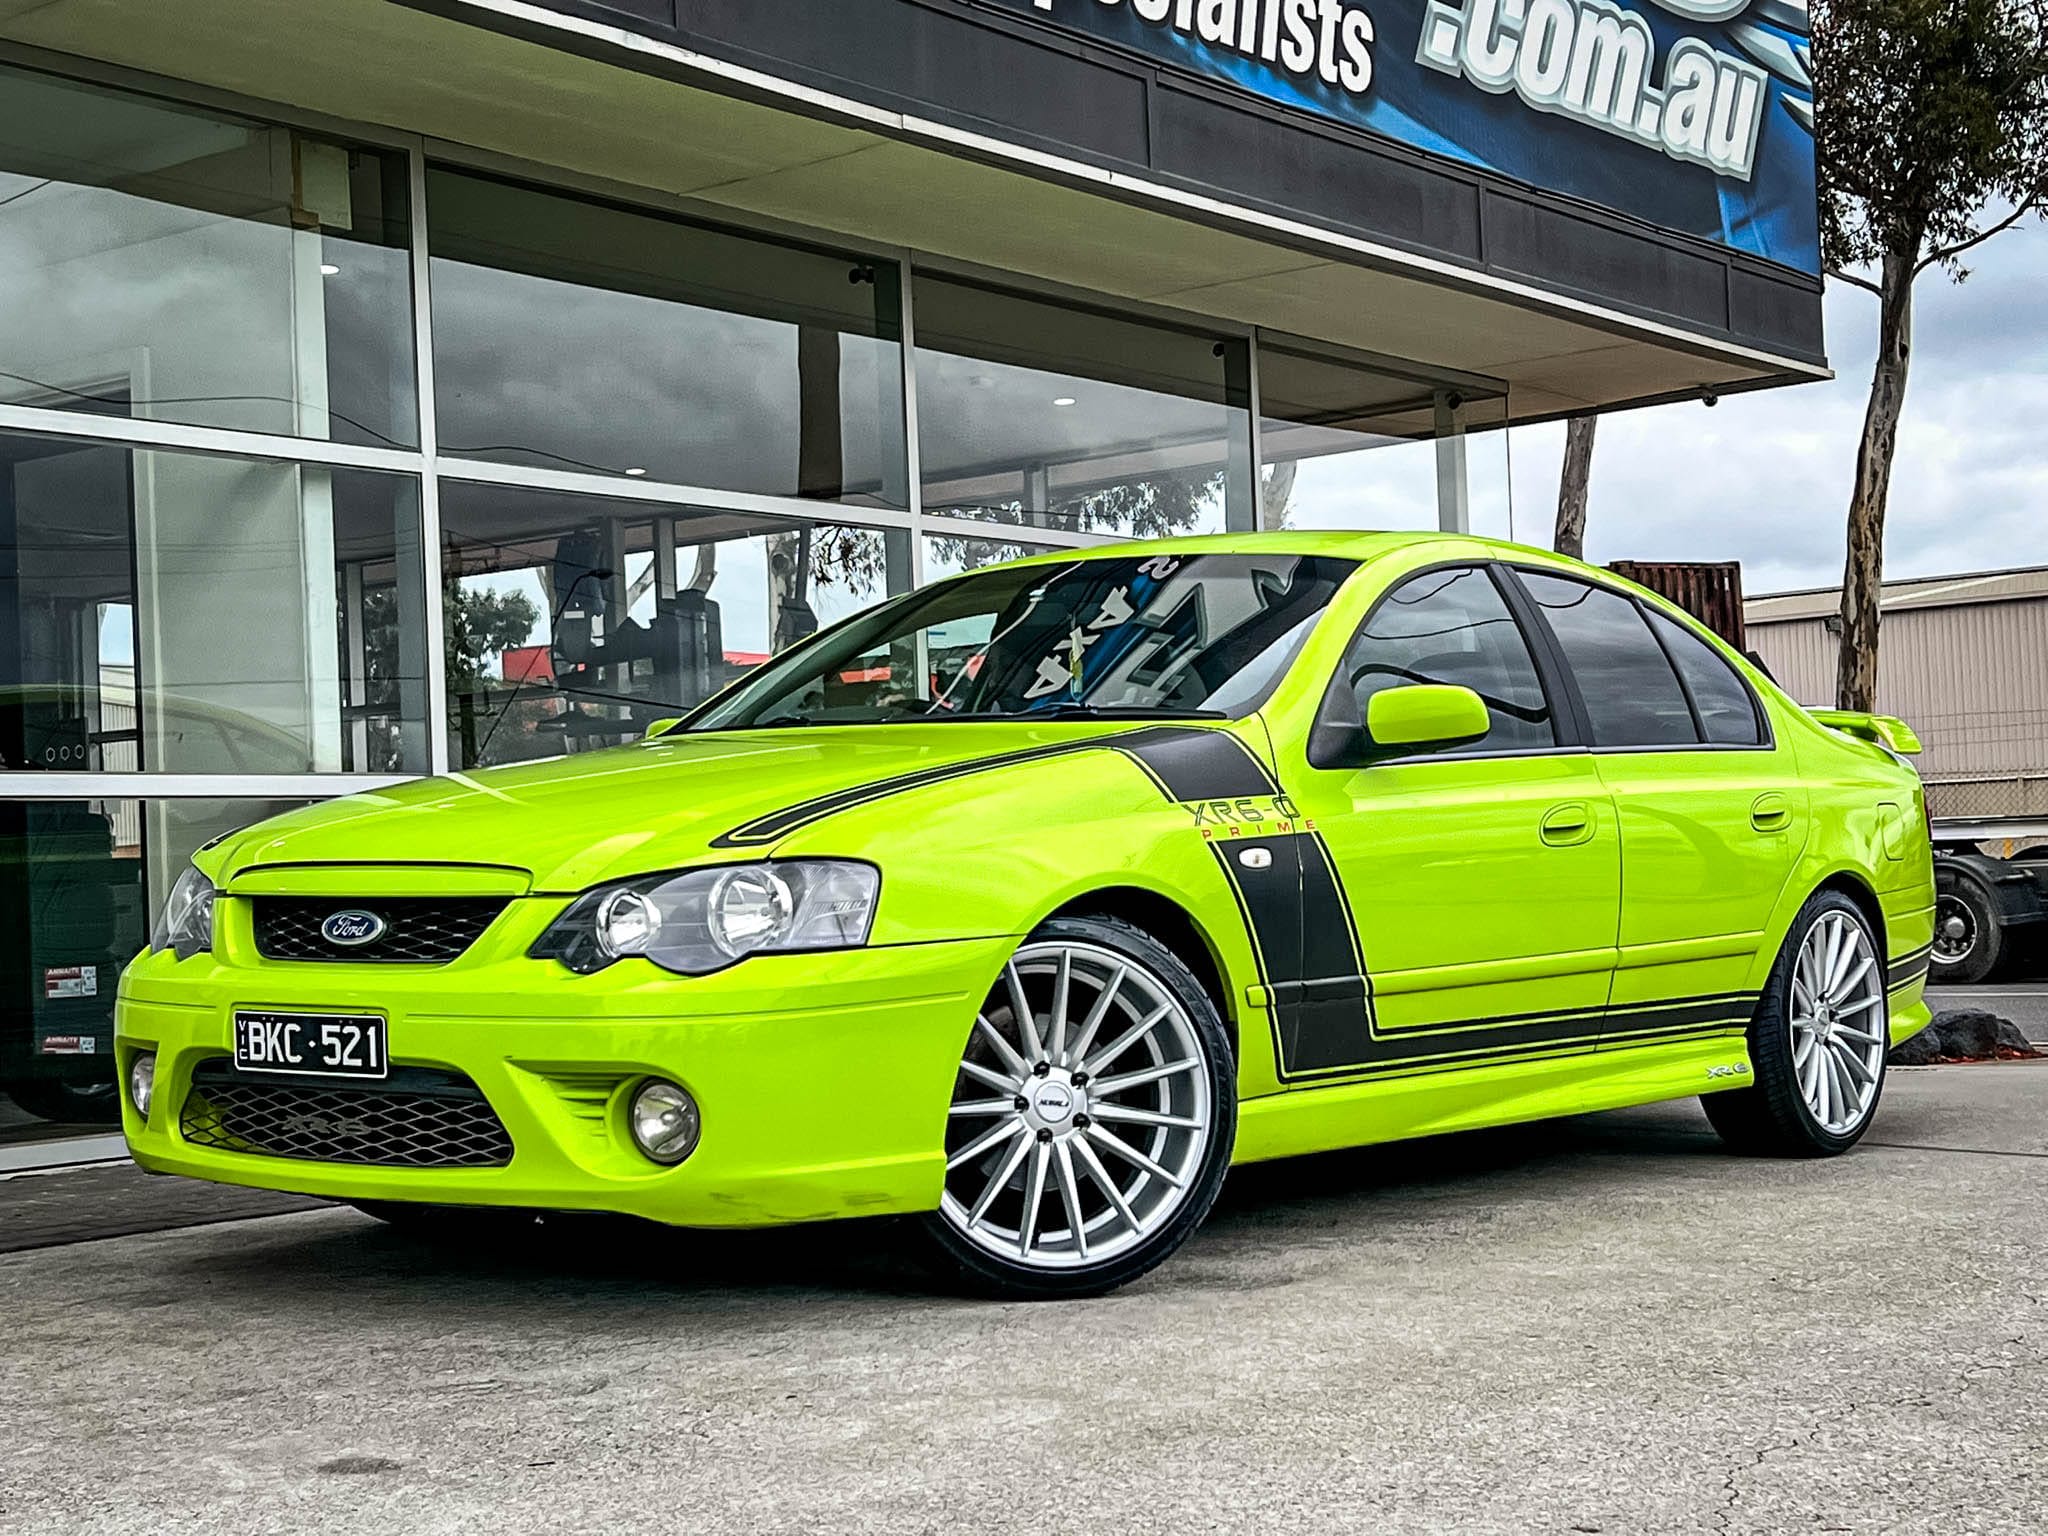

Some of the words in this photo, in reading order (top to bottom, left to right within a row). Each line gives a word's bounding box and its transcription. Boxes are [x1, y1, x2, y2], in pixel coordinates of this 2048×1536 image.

[1425, 0, 1762, 169] .com.au
[1201, 819, 1315, 840] PRIME
[332, 913, 369, 937] Ford
[238, 1020, 249, 1060] VIC
